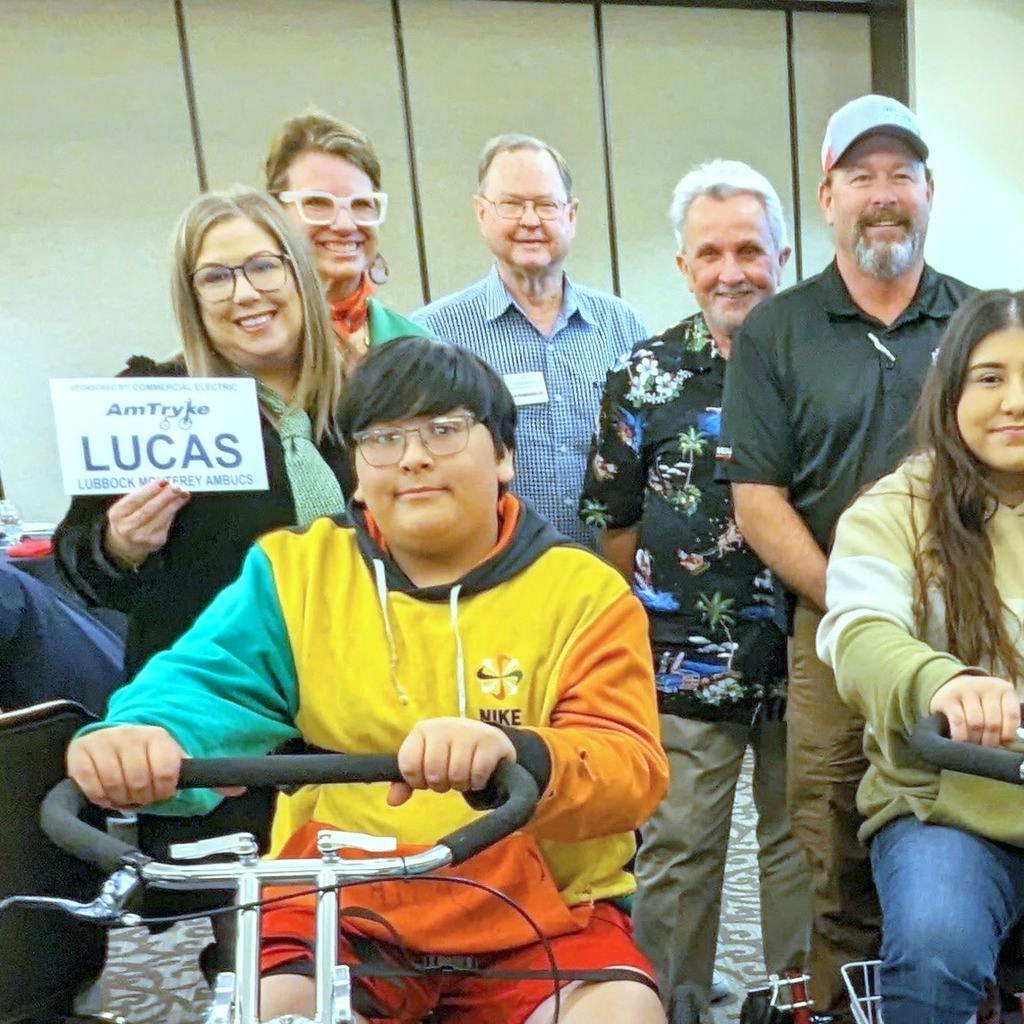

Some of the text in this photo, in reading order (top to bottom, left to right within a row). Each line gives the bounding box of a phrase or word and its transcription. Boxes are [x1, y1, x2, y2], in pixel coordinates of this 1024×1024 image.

[132, 383, 192, 391] COMMERCIAL
[194, 383, 238, 391] ELECTRIC
[105, 397, 211, 419] AmTryke
[81, 433, 243, 472] LUCAS
[77, 473, 254, 490] LUBBOCK MTEREY AMBUCS
[479, 708, 521, 726] NIKE
